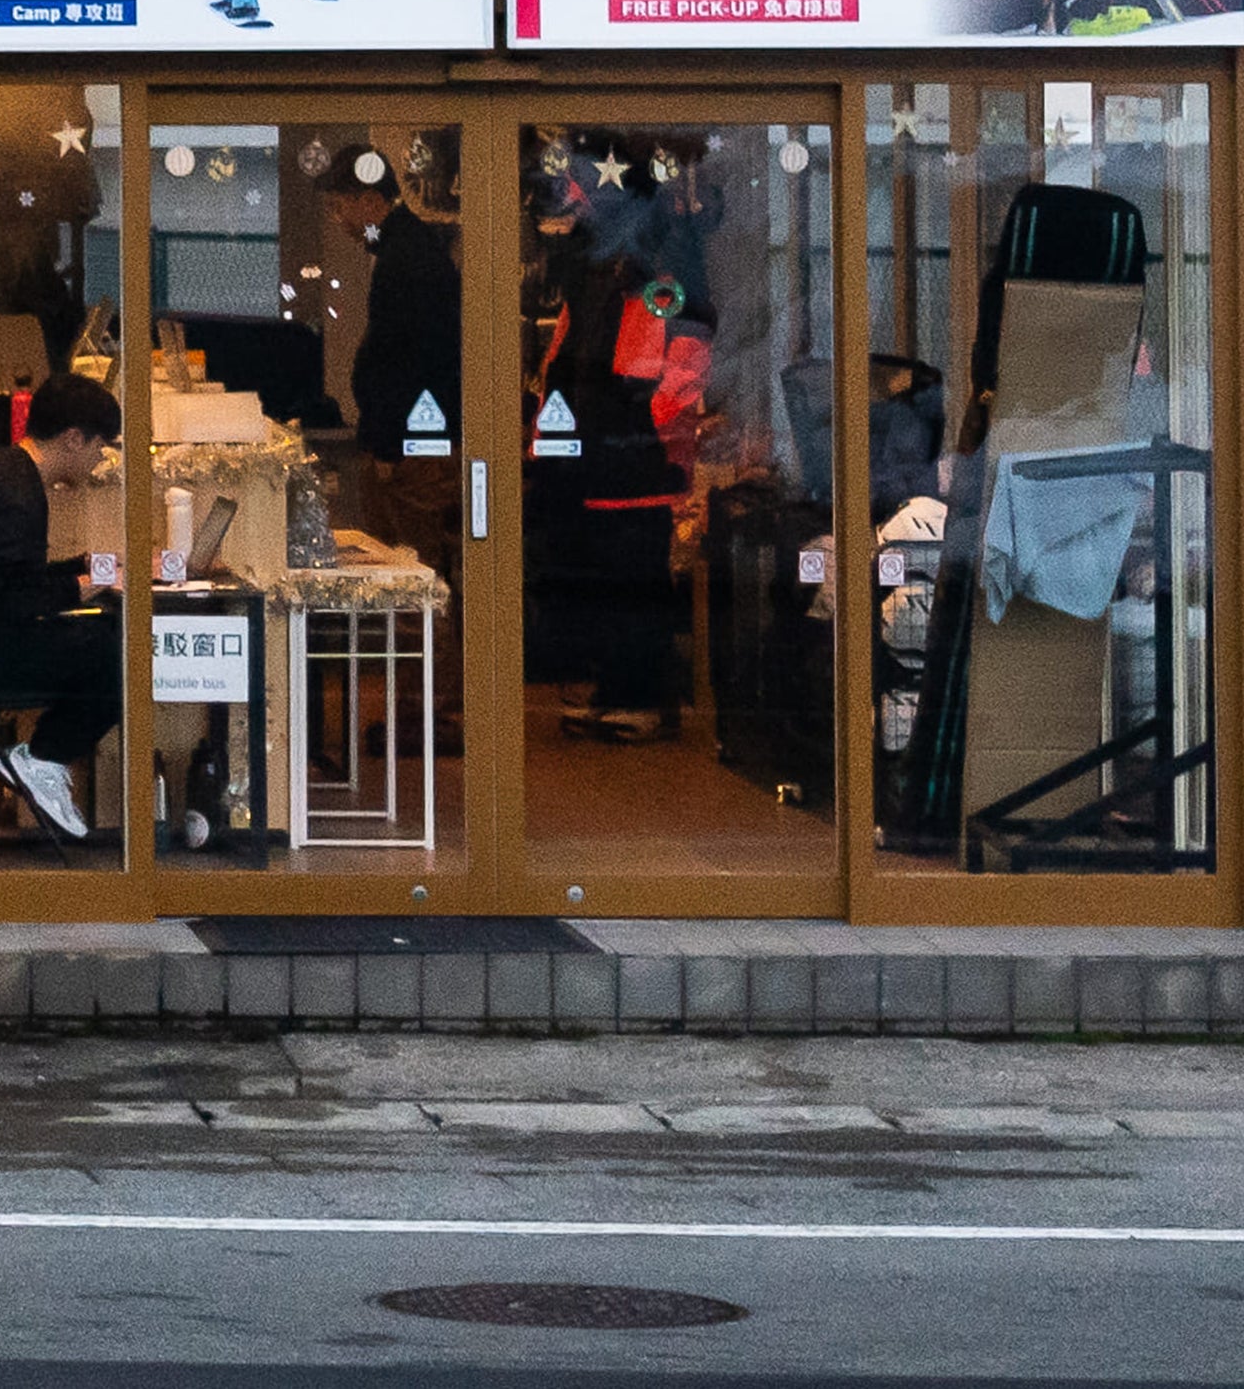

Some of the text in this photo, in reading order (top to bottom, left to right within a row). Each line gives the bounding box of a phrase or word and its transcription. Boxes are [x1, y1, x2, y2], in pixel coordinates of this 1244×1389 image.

[12, 5, 60, 24] Camp
[622, 0, 671, 17] FREE
[677, 0, 759, 17] PICK-UP
[203, 676, 226, 689] bus
